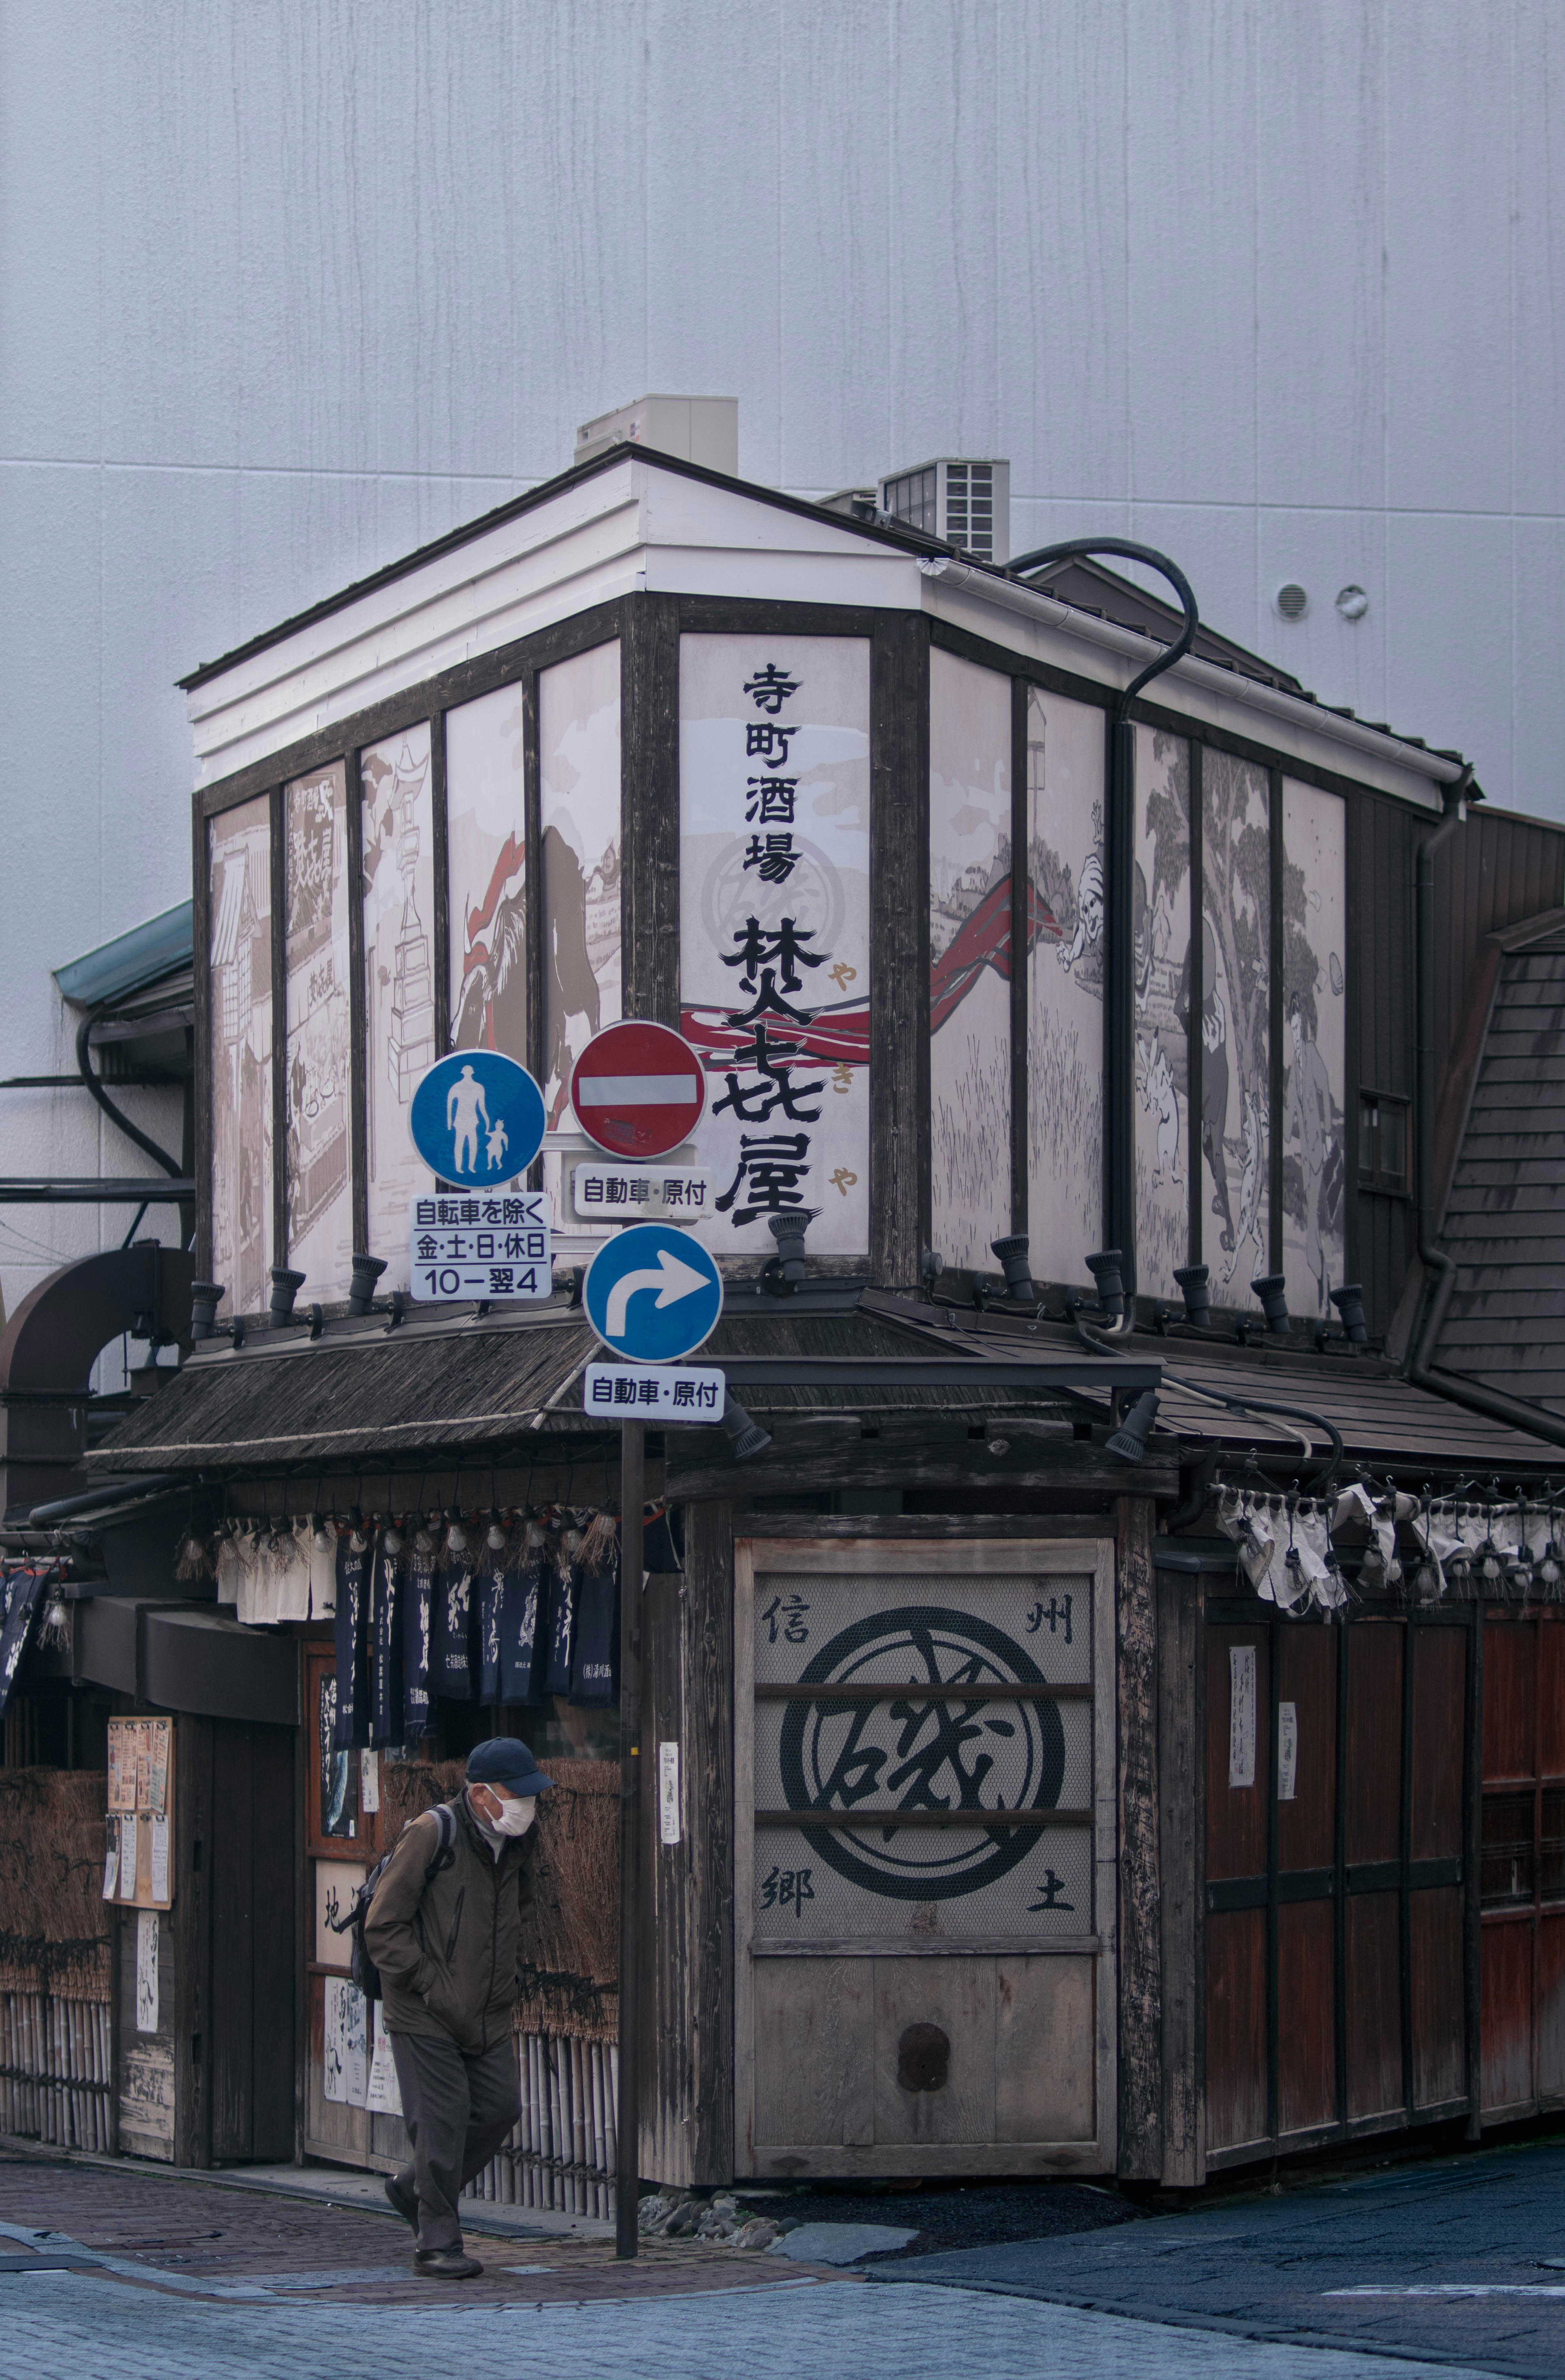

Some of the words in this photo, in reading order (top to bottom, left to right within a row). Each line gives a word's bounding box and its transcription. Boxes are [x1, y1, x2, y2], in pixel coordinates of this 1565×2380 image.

[743, 663, 803, 884] 寺町酒場
[585, 1177, 706, 1205] 自動車・原付
[417, 1198, 543, 1226] 自転車を除く
[417, 1233, 545, 1259] 金・土・日・休日
[593, 1377, 718, 1408] 自動車・原付
